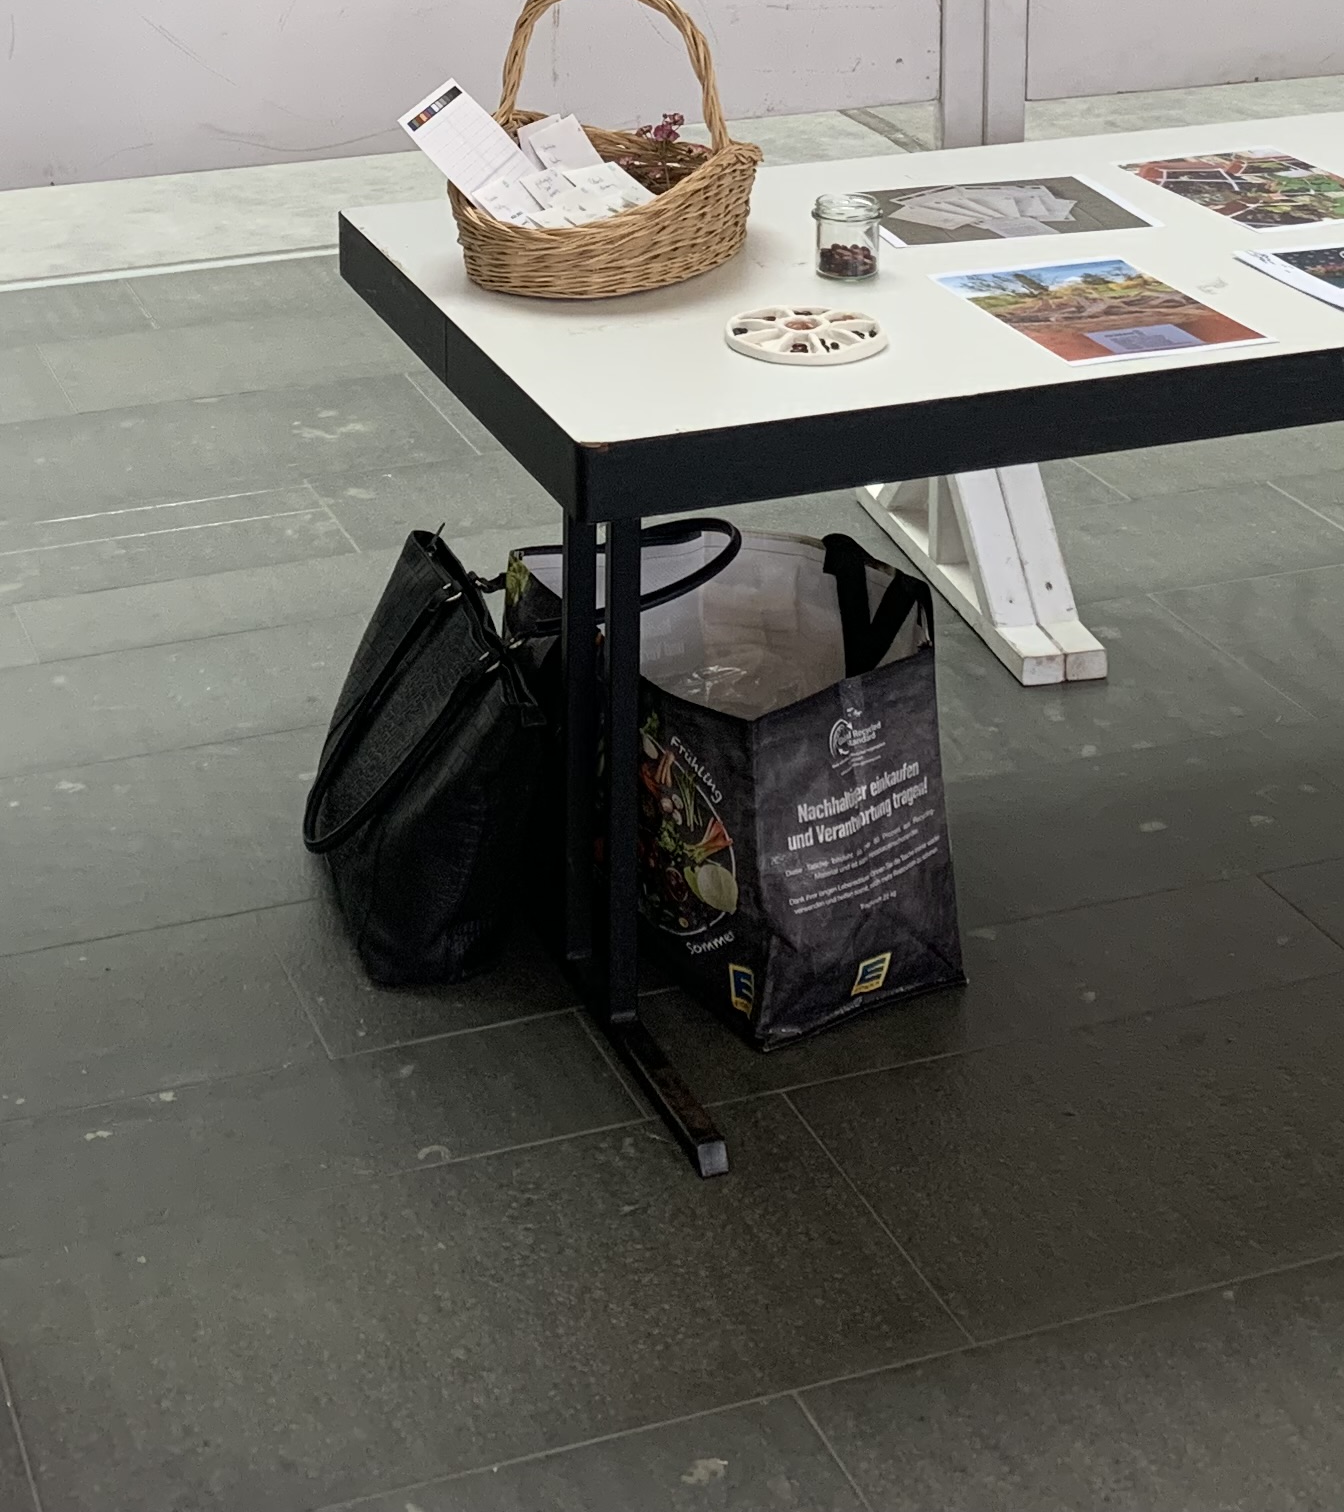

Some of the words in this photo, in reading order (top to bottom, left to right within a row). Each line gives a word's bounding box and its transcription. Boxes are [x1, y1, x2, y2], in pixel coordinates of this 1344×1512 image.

[670, 735, 723, 803] Frühling
[869, 761, 920, 797] einkaufen
[787, 825, 814, 851] und
[892, 776, 928, 809] tragen!
